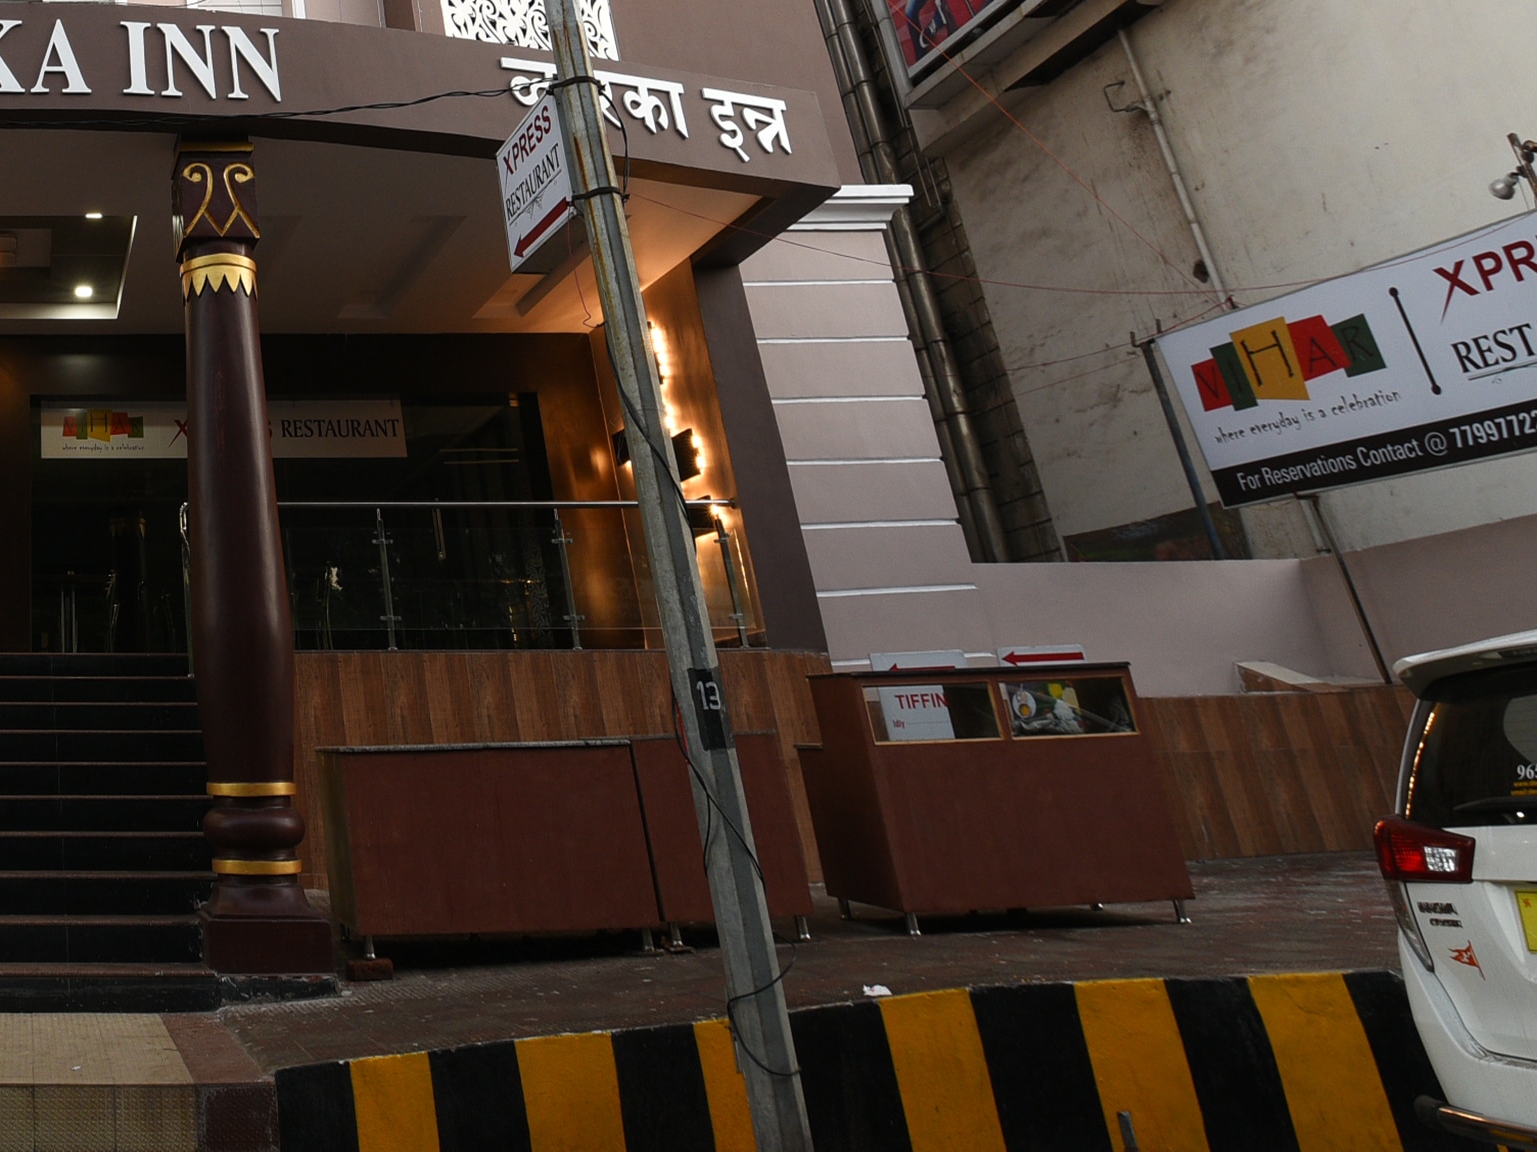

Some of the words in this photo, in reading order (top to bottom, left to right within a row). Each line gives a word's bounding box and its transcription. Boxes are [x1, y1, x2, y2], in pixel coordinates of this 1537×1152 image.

[120, 20, 280, 102] INN
[503, 105, 552, 178] XPRESS
[505, 143, 560, 221] RESTAURANT
[1432, 235, 1537, 325] XPR
[1196, 325, 1375, 401] VIHAR
[1451, 323, 1536, 373] REST
[281, 419, 400, 438] RESTAURANT
[1215, 427, 1246, 444] where
[1250, 412, 1302, 436] everyday
[1302, 408, 1315, 422] is
[1318, 408, 1327, 418] a
[1331, 390, 1402, 416] celebration
[1236, 472, 1262, 491] For
[1261, 455, 1357, 486] Reservations
[1356, 437, 1421, 467] Contact
[1424, 431, 1447, 456] @
[696, 680, 722, 710] 13
[894, 692, 950, 710] TIFFIN
